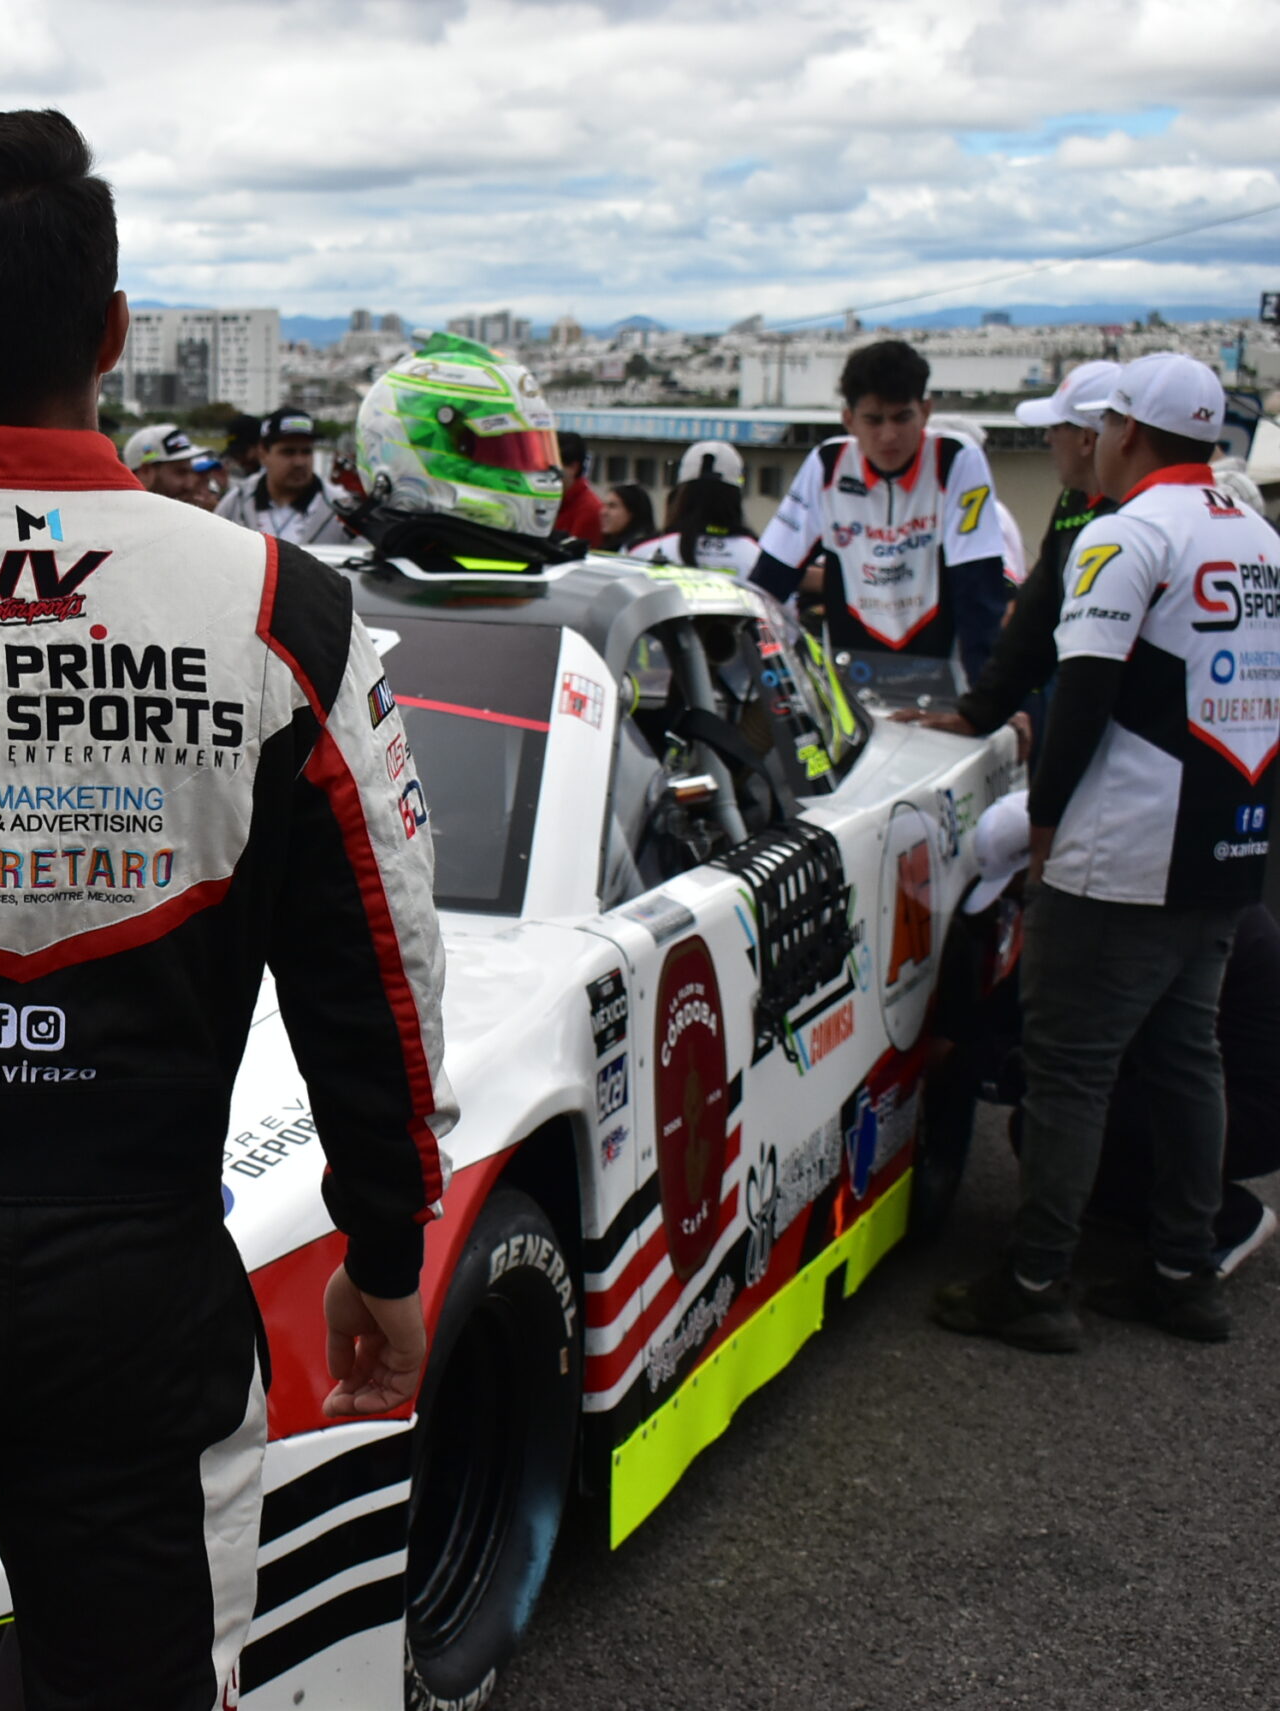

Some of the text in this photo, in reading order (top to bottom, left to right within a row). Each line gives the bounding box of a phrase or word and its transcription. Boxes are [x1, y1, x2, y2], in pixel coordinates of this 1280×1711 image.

[958, 485, 990, 534] 7
[1073, 544, 1122, 599] 7
[6, 695, 244, 748] SPORTS
[8, 744, 241, 770] ENTERTAINMENT
[9, 813, 164, 833] ADVERTISING
[23, 891, 84, 904] ENCONTRE
[87, 890, 136, 904] MEXICO.
[661, 999, 717, 1068] CÓRDOBA
[488, 1233, 577, 1339] GENERAL
